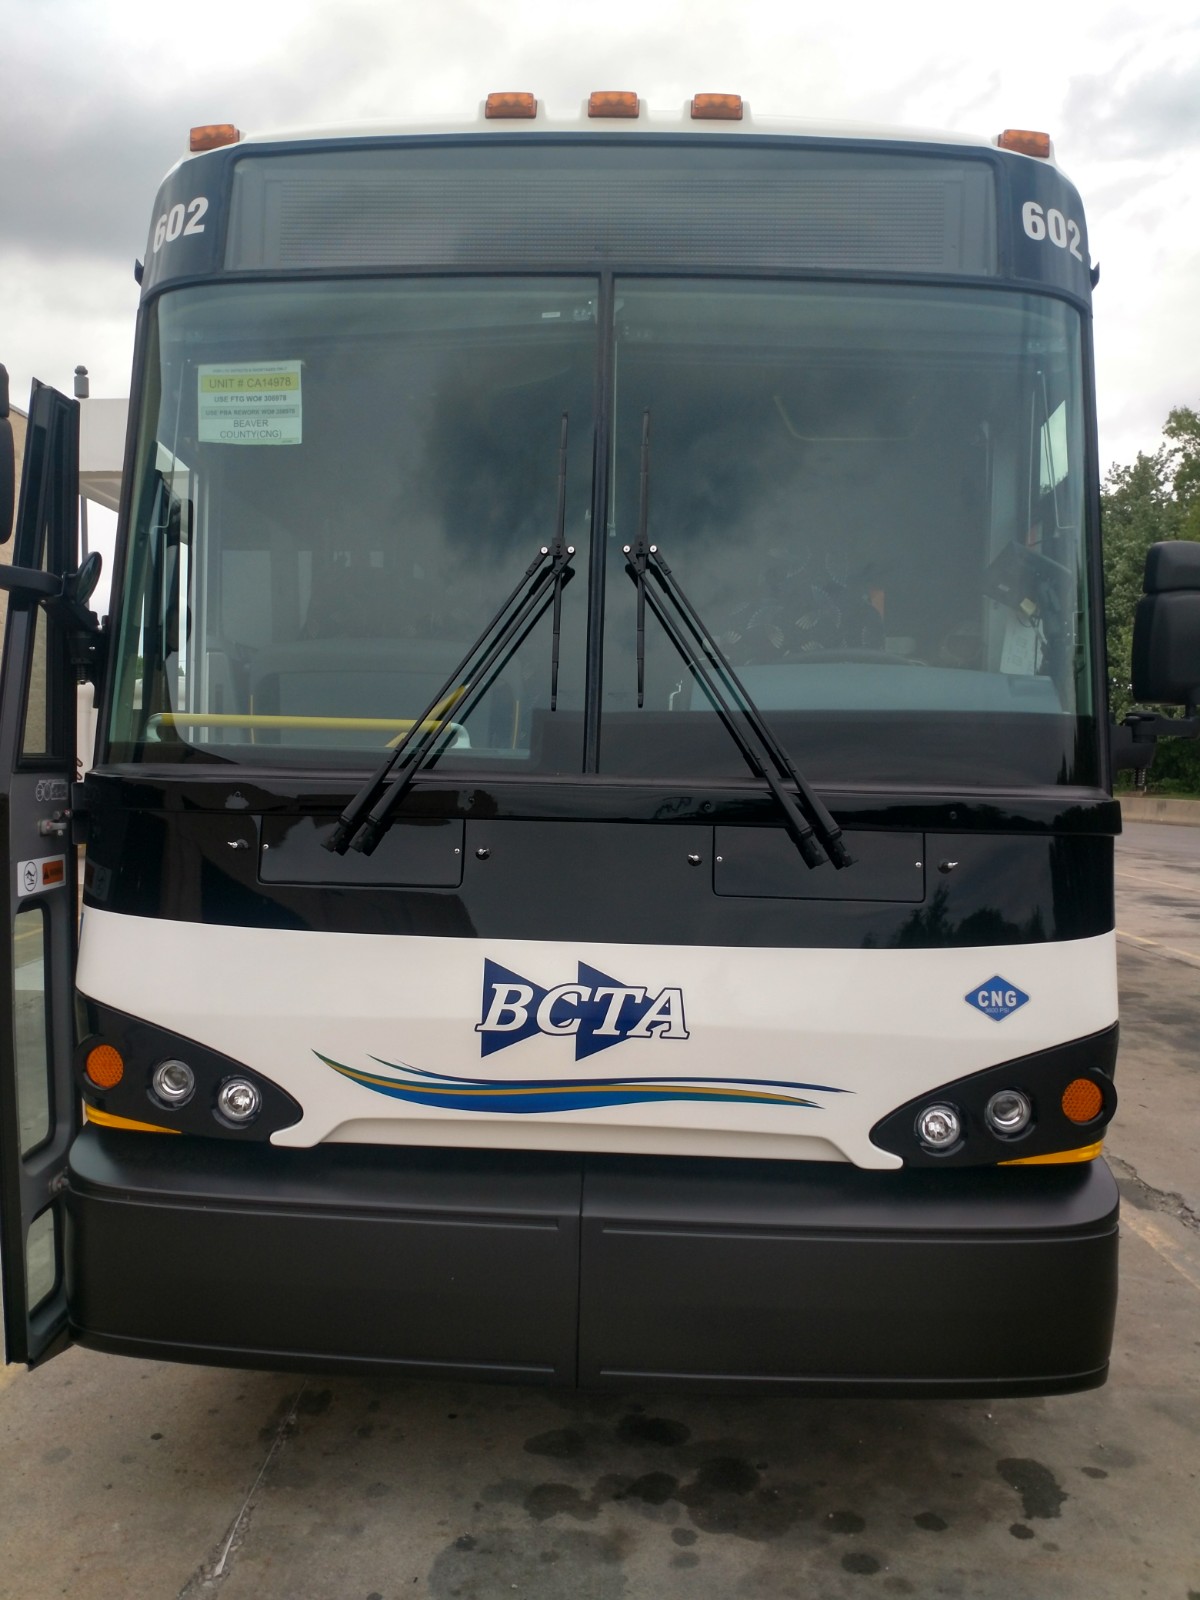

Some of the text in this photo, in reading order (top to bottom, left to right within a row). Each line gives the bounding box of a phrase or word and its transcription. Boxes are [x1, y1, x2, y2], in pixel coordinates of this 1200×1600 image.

[153, 196, 209, 254] 602
[1022, 201, 1083, 262] 602
[209, 376, 292, 389] UNIT # CA14978
[214, 395, 229, 403] USE
[233, 419, 269, 428] BEAVER
[219, 429, 282, 439] COUNTY(CNG)
[977, 990, 1017, 1007] CNG
[474, 982, 690, 1040] BCTA
